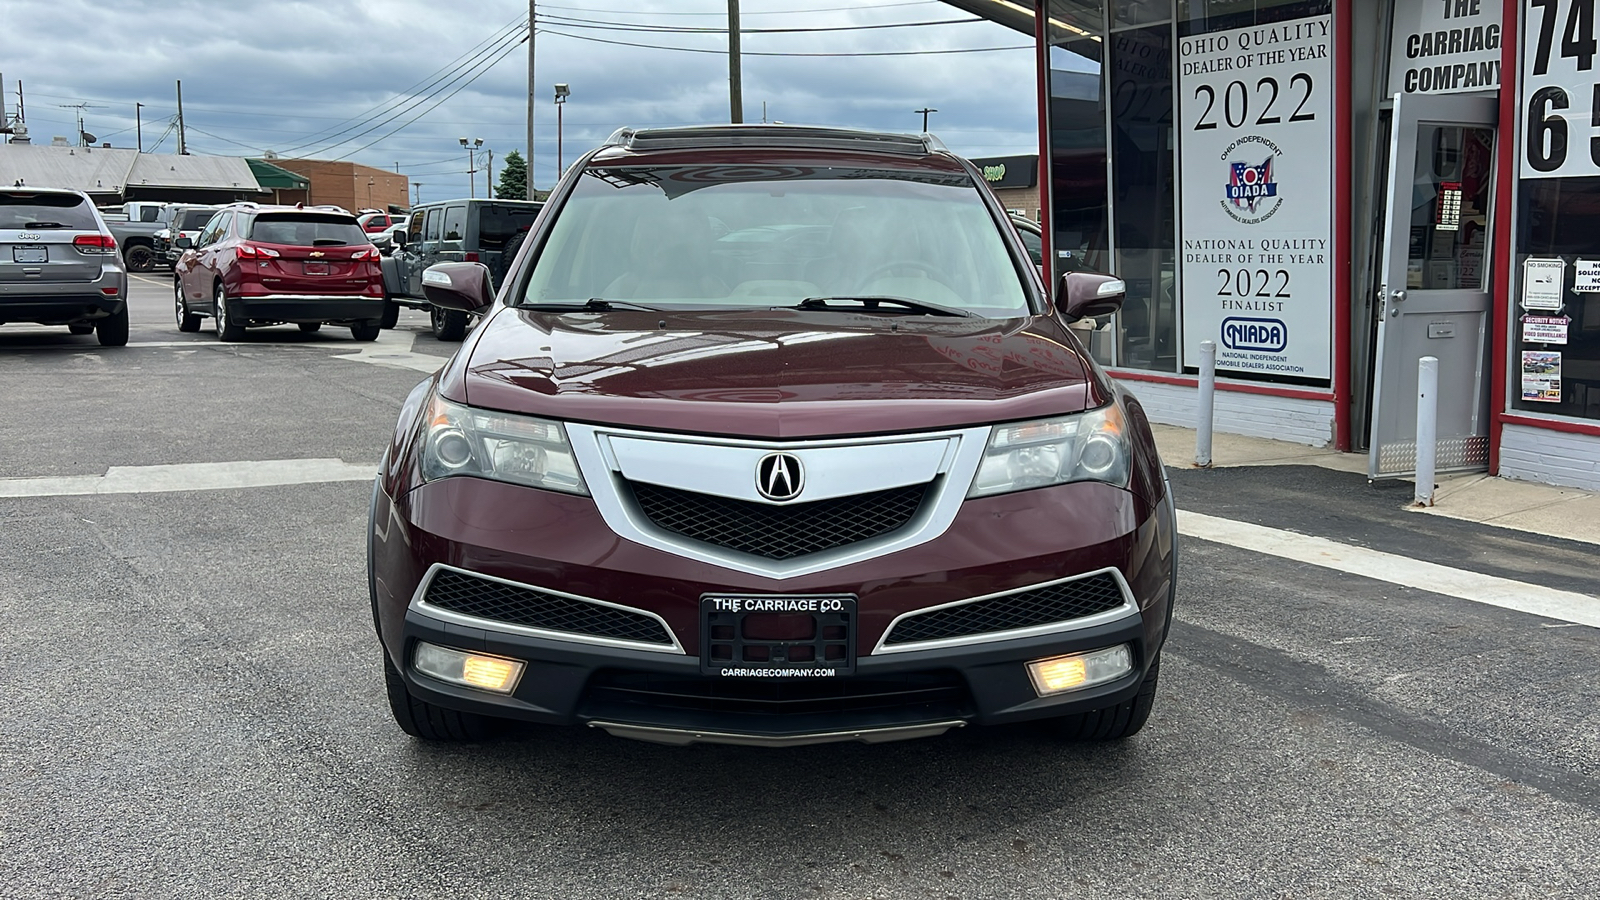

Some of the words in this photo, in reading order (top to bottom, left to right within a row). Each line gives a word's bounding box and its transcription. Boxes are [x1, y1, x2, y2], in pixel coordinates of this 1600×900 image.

[1442, 0, 1480, 19] THE
[1181, 35, 1229, 57] OHIO
[1238, 19, 1330, 51] QUALITY
[1407, 24, 1502, 59] CARRIAG
[1530, 0, 1597, 76] 74
[1183, 57, 1233, 76] DEALER
[1236, 54, 1254, 69] OF
[1257, 49, 1286, 66] THE
[1288, 44, 1328, 62] YEAR
[1193, 72, 1315, 131] 2022
[1220, 142, 1236, 161] OHIO
[1236, 135, 1283, 157] INDEPENDENT
[983, 163, 1006, 181] SHOP
[1231, 184, 1269, 198] OIADA
[1220, 200, 1242, 223] AUTOMOBILE
[1242, 217, 1260, 225] DEALERS
[1260, 197, 1284, 222] ASSOCIATION
[18, 232, 40, 240] Jeep
[1185, 239, 1255, 250] NATIONAL
[1261, 239, 1327, 252] QUALITY
[1186, 253, 1233, 263] DEALER
[1237, 253, 1253, 264] OF
[1259, 254, 1284, 264] THE
[1290, 254, 1325, 264] YEAR
[1217, 268, 1291, 298] 2022
[1222, 300, 1284, 312] FINALIST
[1226, 324, 1281, 346] NIADA
[1222, 352, 1248, 360] NATIONAL
[1249, 354, 1288, 363] INDEPENDENT
[1241, 361, 1264, 369] DEALERS
[1265, 363, 1304, 373] ASSOCIATION
[713, 598, 741, 611] THE
[744, 599, 817, 611] CARRIAGE
[820, 599, 844, 611] CO.
[720, 668, 836, 677] CARRIAGECOMPANY.COM
